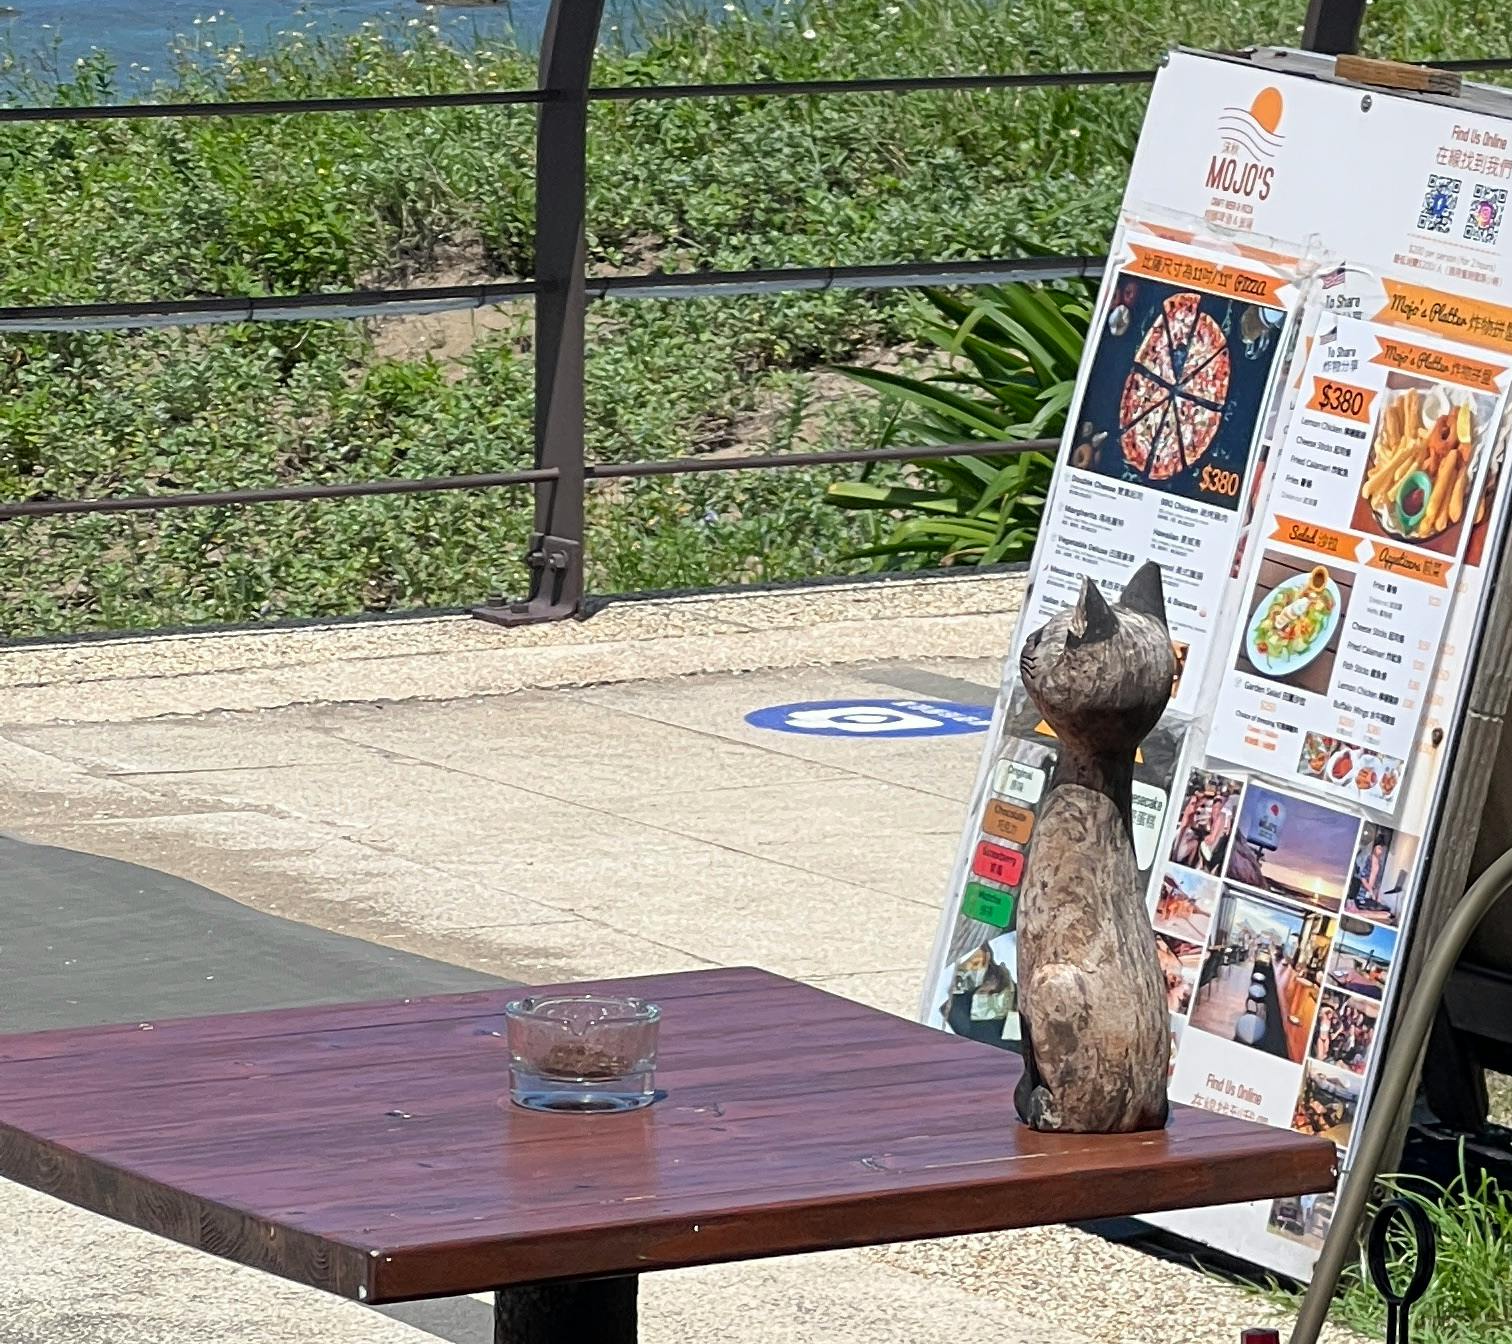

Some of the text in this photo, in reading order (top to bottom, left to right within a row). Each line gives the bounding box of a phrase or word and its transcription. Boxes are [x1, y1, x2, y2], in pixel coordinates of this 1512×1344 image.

[1452, 125, 1507, 149] Find Us Online
[1205, 155, 1274, 200] MOJO'S
[1435, 146, 1512, 178] 在線找到我們
[1318, 381, 1364, 418] $380
[1200, 464, 1239, 496] $380
[1206, 1073, 1262, 1105] Find Us Online
